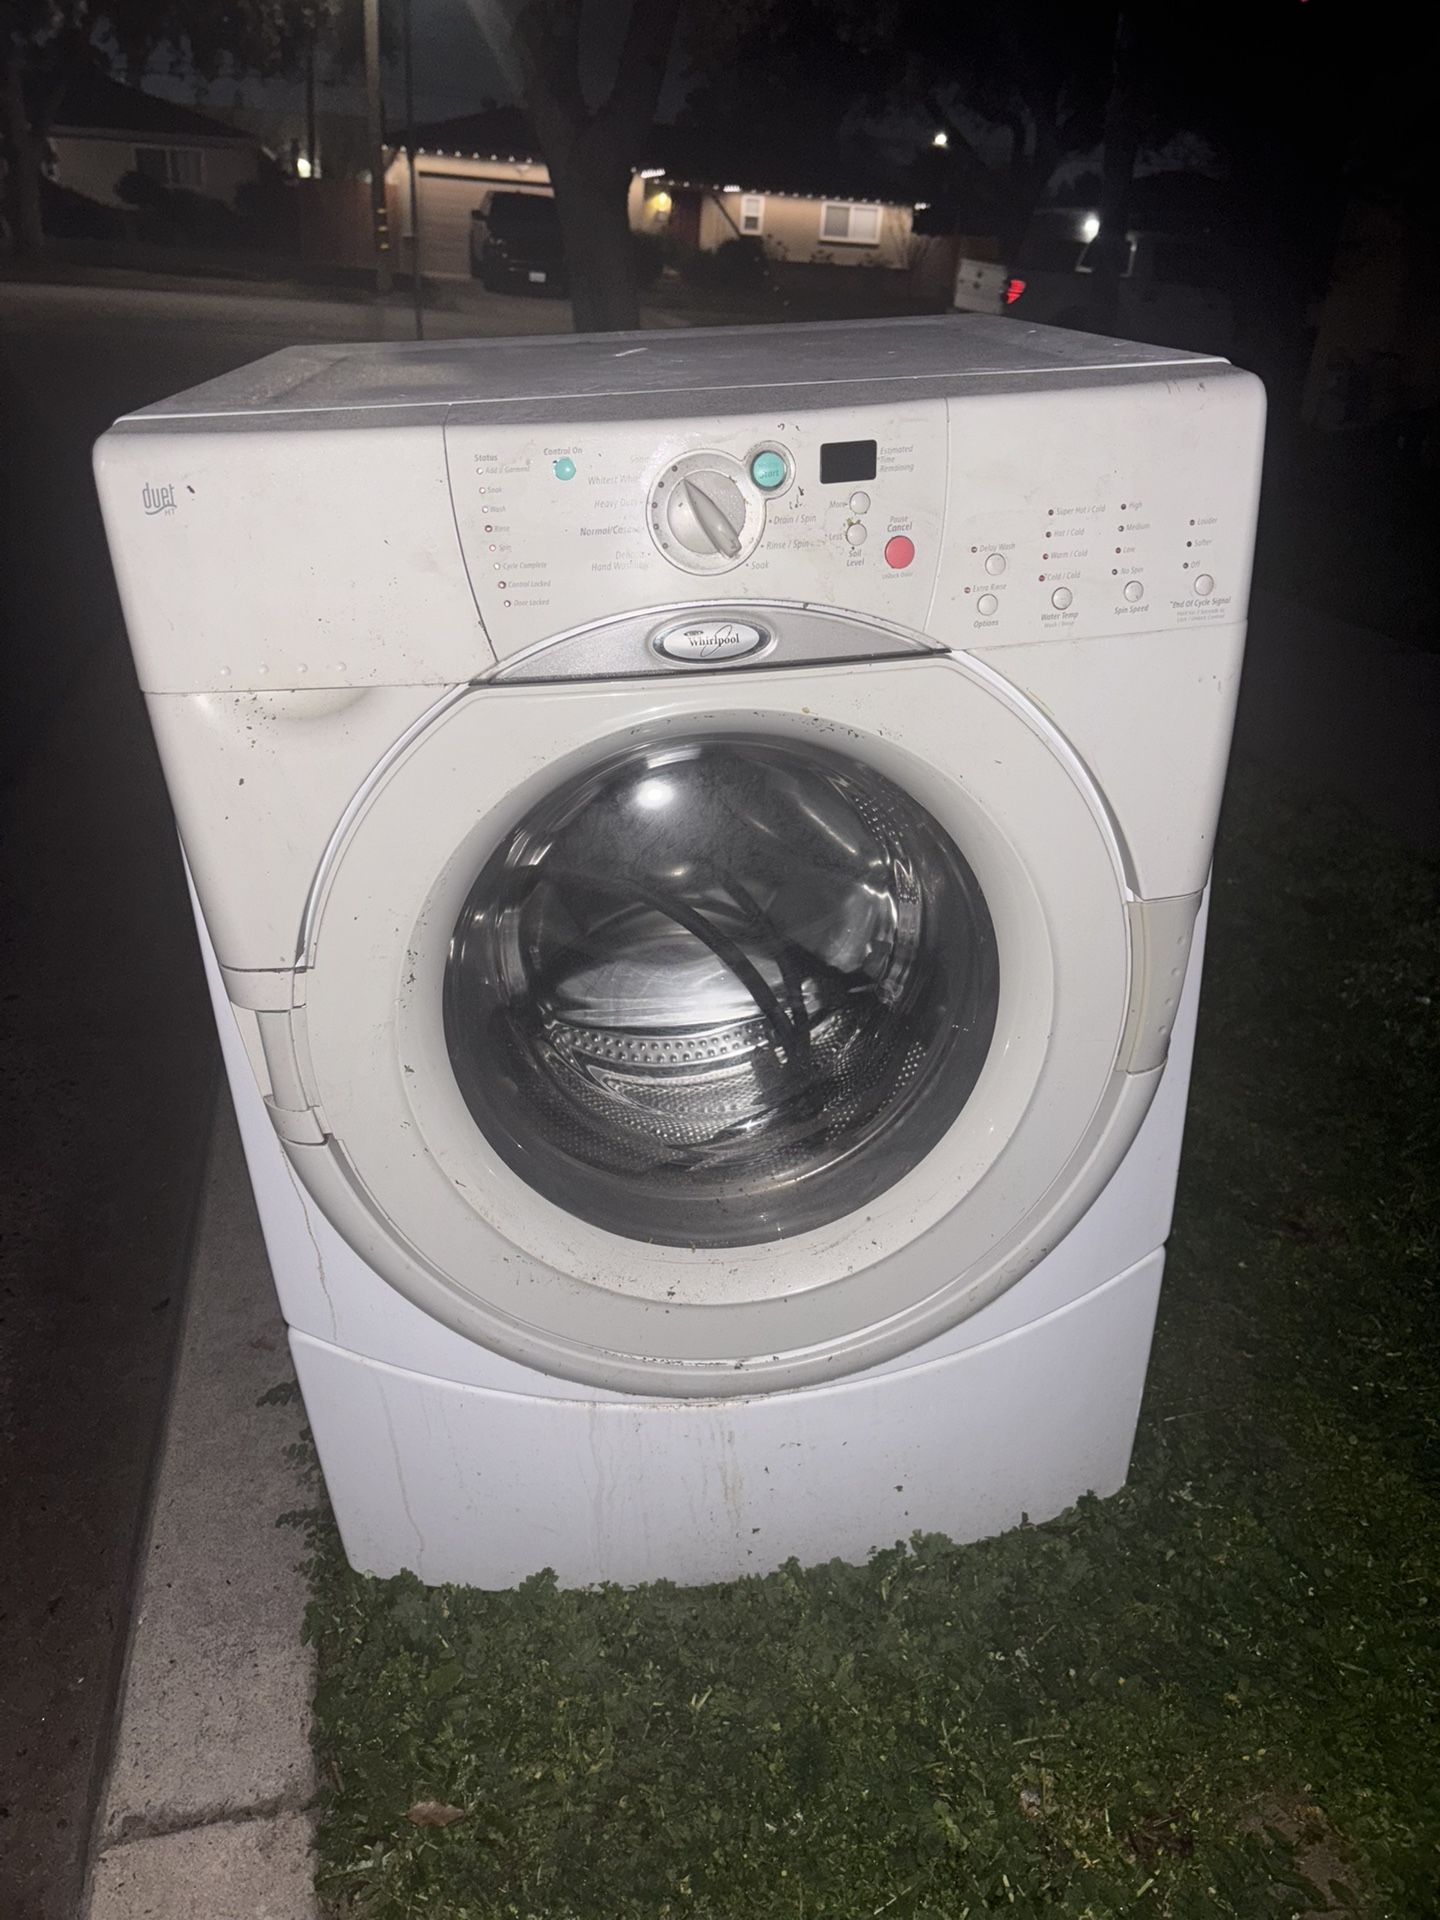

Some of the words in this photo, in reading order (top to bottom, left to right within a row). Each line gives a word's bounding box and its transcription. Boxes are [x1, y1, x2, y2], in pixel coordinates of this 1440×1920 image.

[543, 447, 572, 456] Control
[572, 446, 583, 454] On
[474, 454, 498, 462] Status
[142, 482, 175, 509] duet
[774, 516, 794, 525] Drain
[801, 513, 816, 525] Spin
[887, 522, 913, 533] Cancel
[766, 542, 786, 550] Rinse
[592, 562, 612, 571] Hand
[751, 560, 769, 569] Soak
[846, 559, 865, 567] Level
[1114, 607, 1129, 616] Spin
[1129, 604, 1150, 615] Speed
[1041, 613, 1062, 621] Water
[1062, 611, 1080, 621] Temp
[973, 620, 999, 629] Options
[689, 633, 740, 647] Whirlpool
